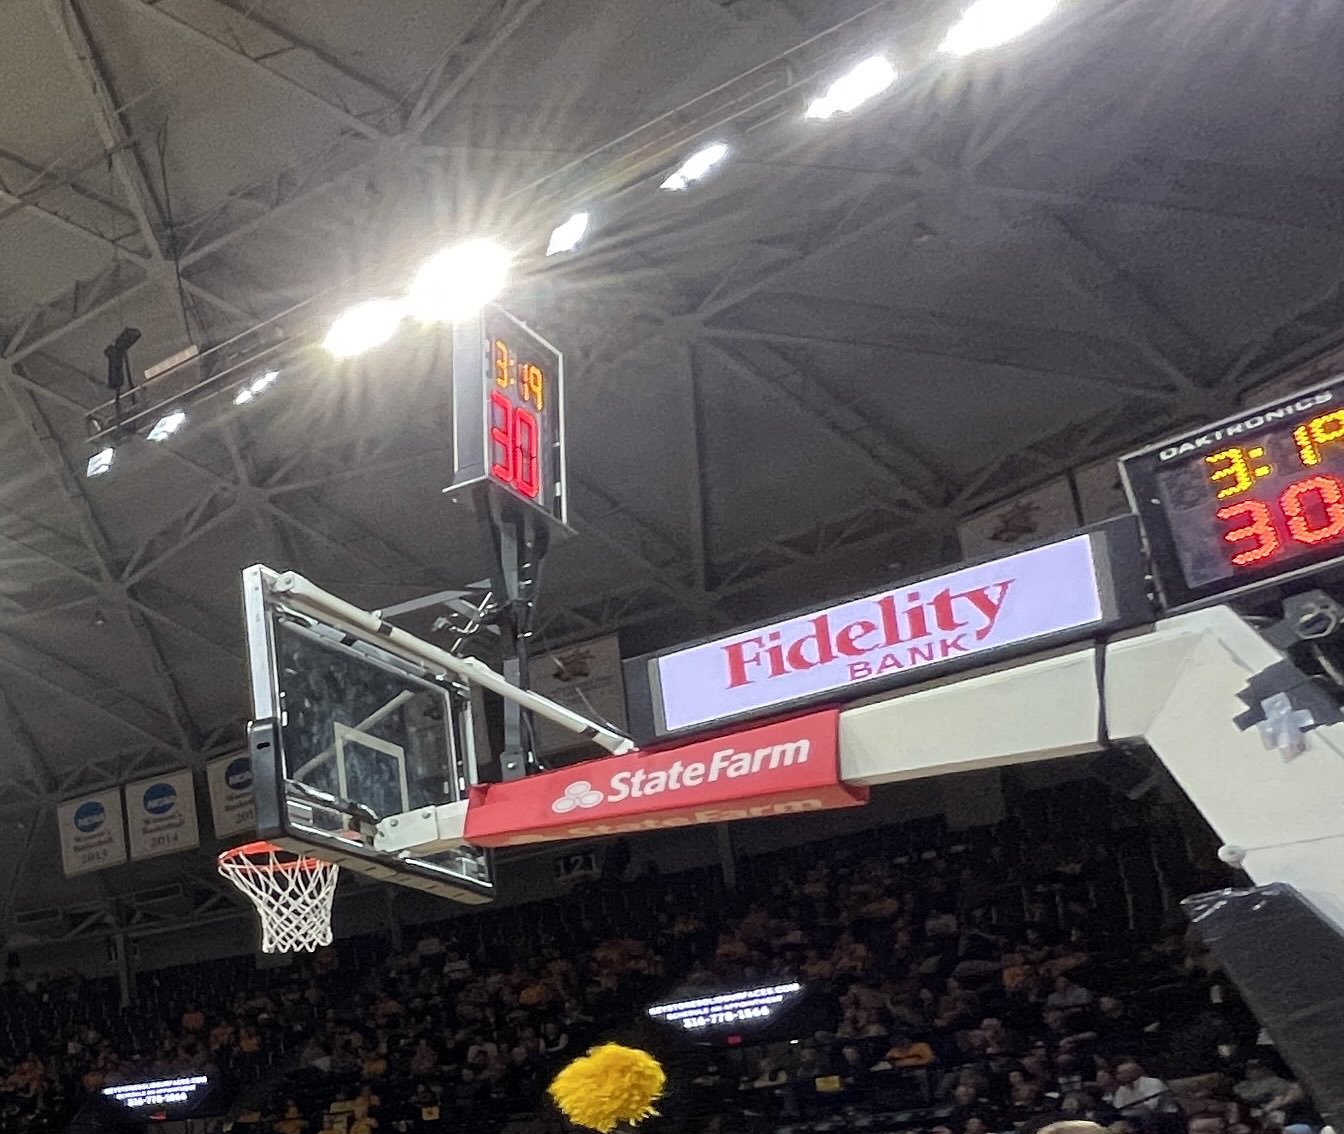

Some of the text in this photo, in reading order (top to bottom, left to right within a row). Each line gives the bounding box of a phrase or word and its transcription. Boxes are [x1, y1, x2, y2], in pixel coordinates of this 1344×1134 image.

[495, 339, 545, 412] 3:19
[490, 390, 540, 499] 30
[1158, 390, 1333, 461] DAKTRONICS
[1216, 475, 1344, 567] 30
[721, 578, 1016, 690] Fidelity
[849, 633, 973, 682] BANK
